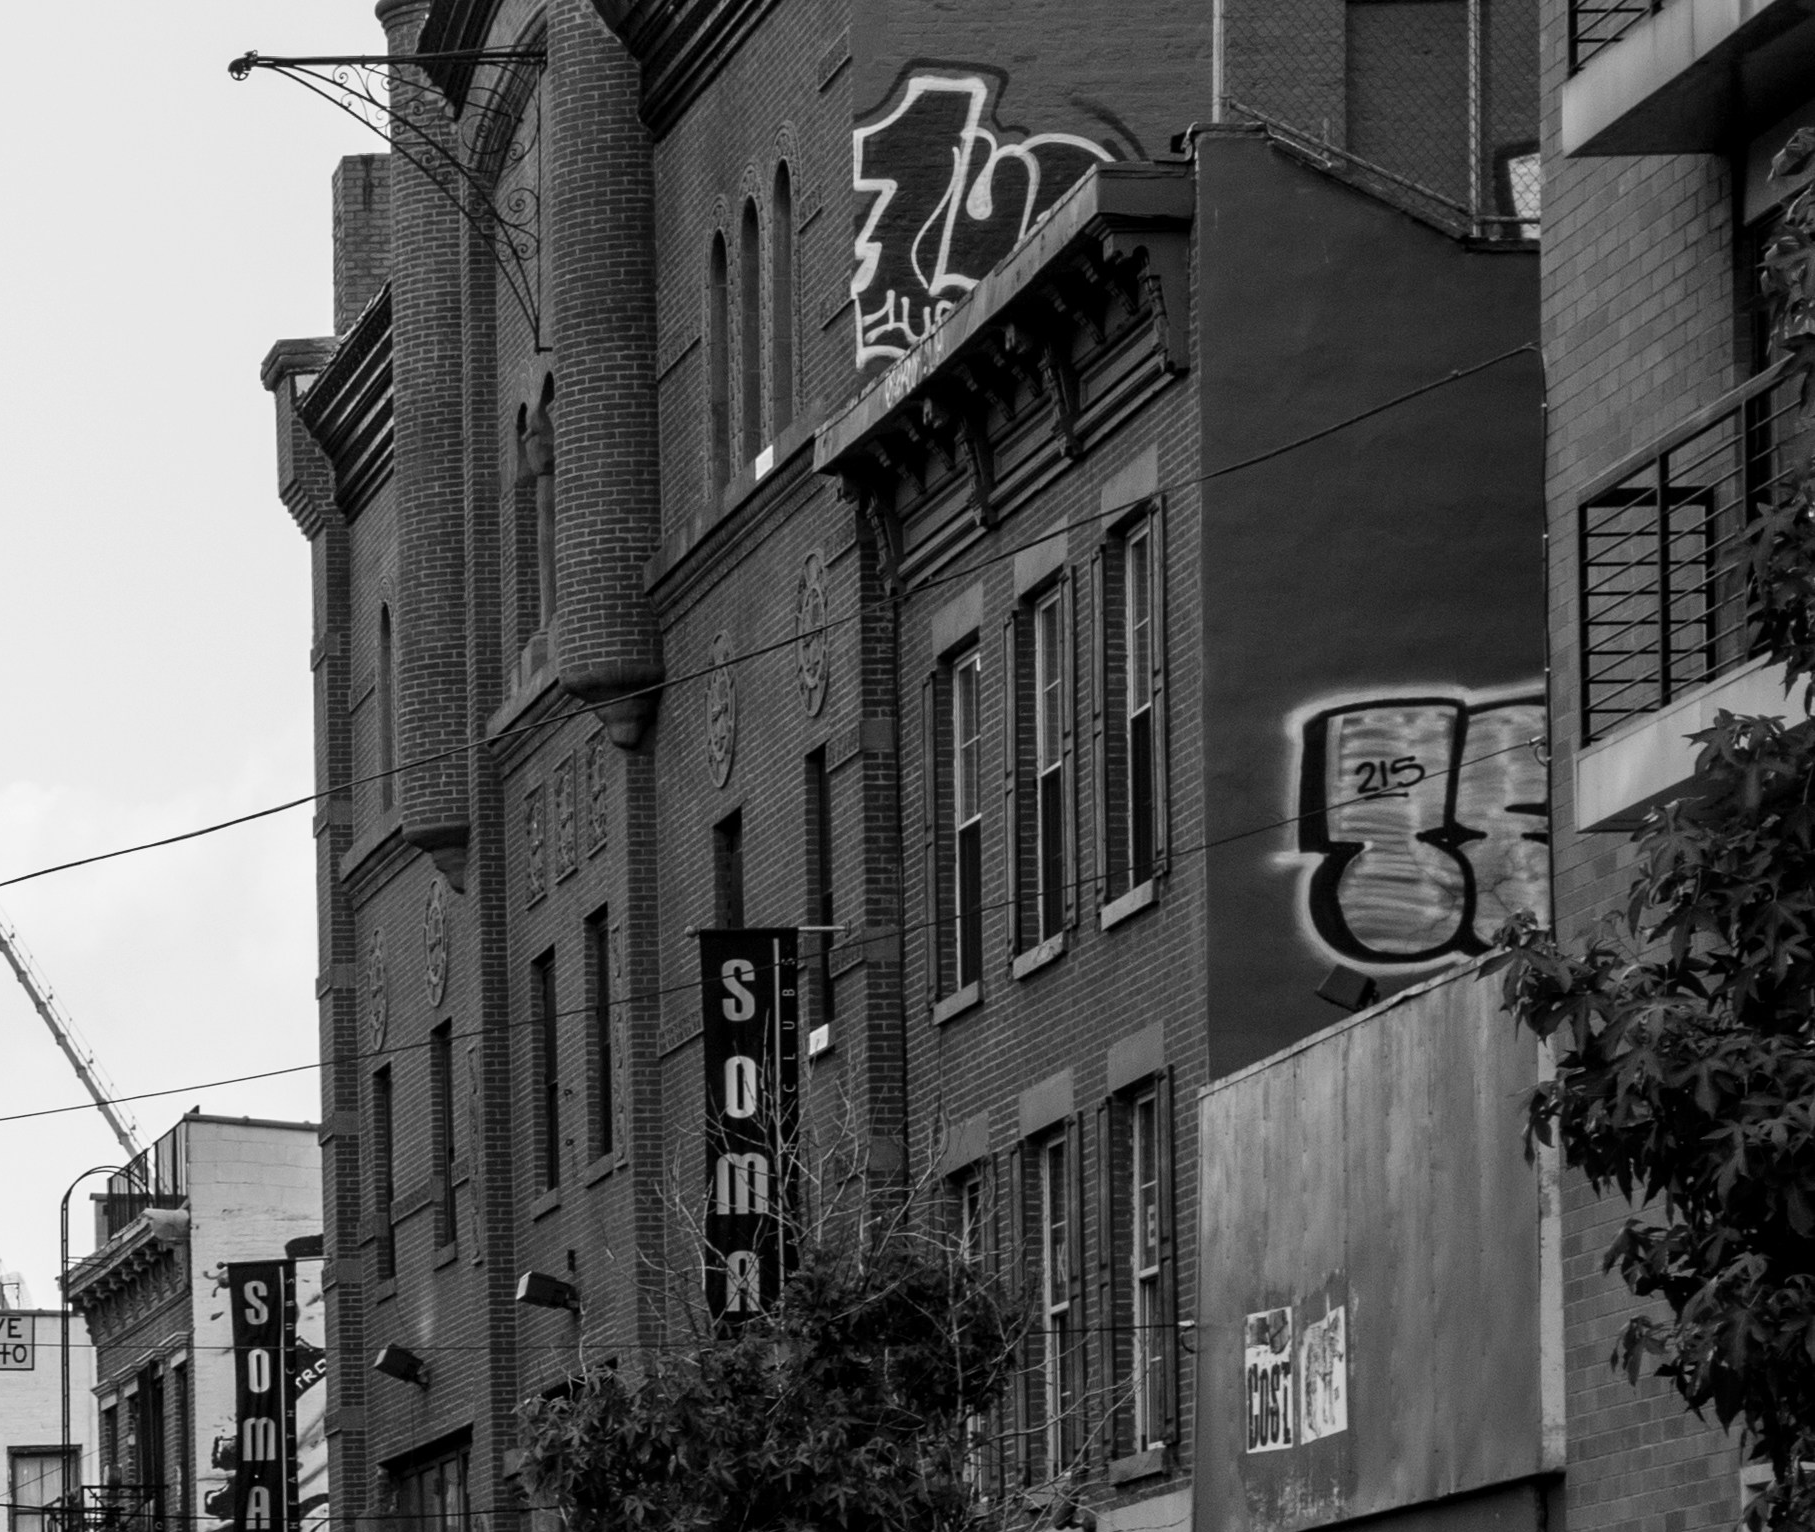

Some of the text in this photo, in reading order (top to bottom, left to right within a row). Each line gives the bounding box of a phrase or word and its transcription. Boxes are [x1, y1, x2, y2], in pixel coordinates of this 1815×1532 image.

[1355, 755, 1425, 795] 215
[781, 956, 798, 1094] CLUBS
[285, 1409, 299, 1530] HEALTH
